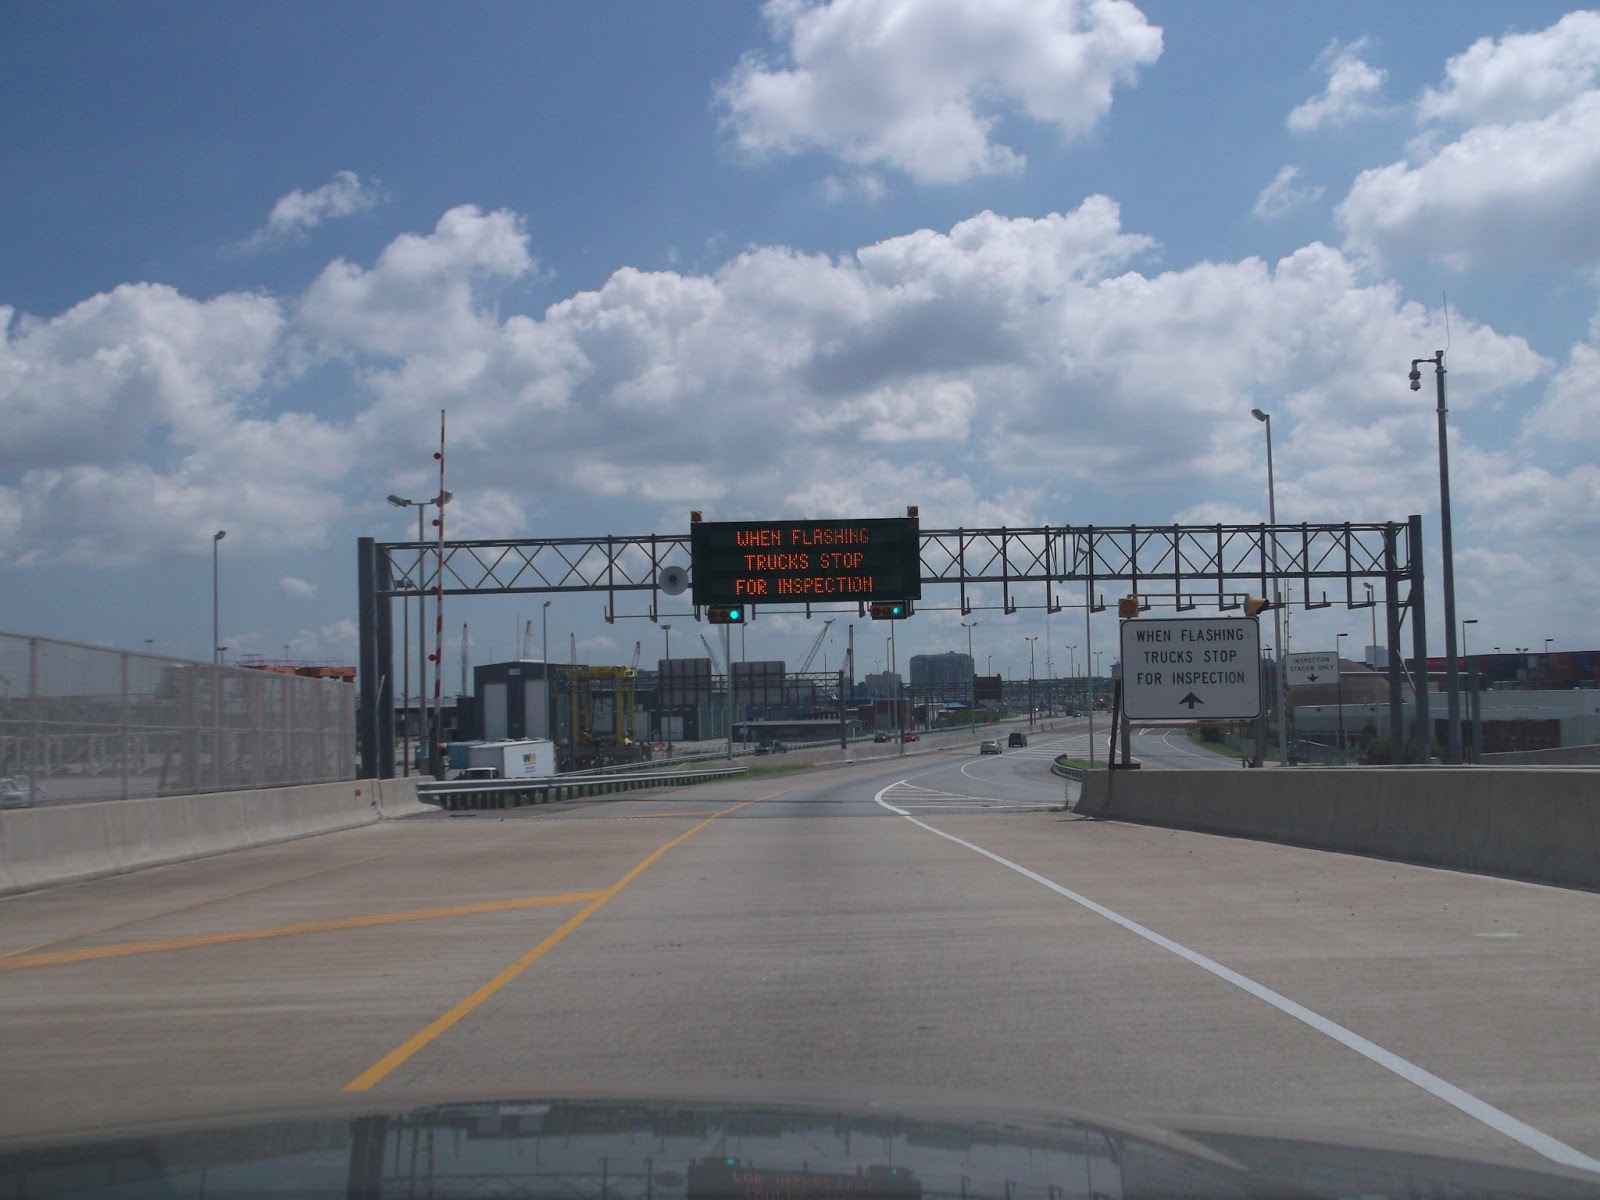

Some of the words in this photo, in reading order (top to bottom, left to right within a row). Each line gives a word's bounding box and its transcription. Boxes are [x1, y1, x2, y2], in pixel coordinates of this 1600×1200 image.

[736, 530, 781, 547] WHEN
[792, 528, 870, 546] FLASHING
[744, 553, 809, 571] TRUCKS
[820, 552, 864, 569] STOP
[736, 578, 767, 596] FOR
[778, 576, 874, 594] INSPECTION
[1136, 629, 1171, 643] WHEN
[1181, 628, 1244, 642] FLASHING
[1144, 651, 1193, 664] TRUCKS
[1204, 650, 1237, 663] STOP
[1294, 656, 1330, 664] INSPECTION
[1137, 672, 1162, 685] FOR
[1172, 671, 1245, 685] INSPECTION
